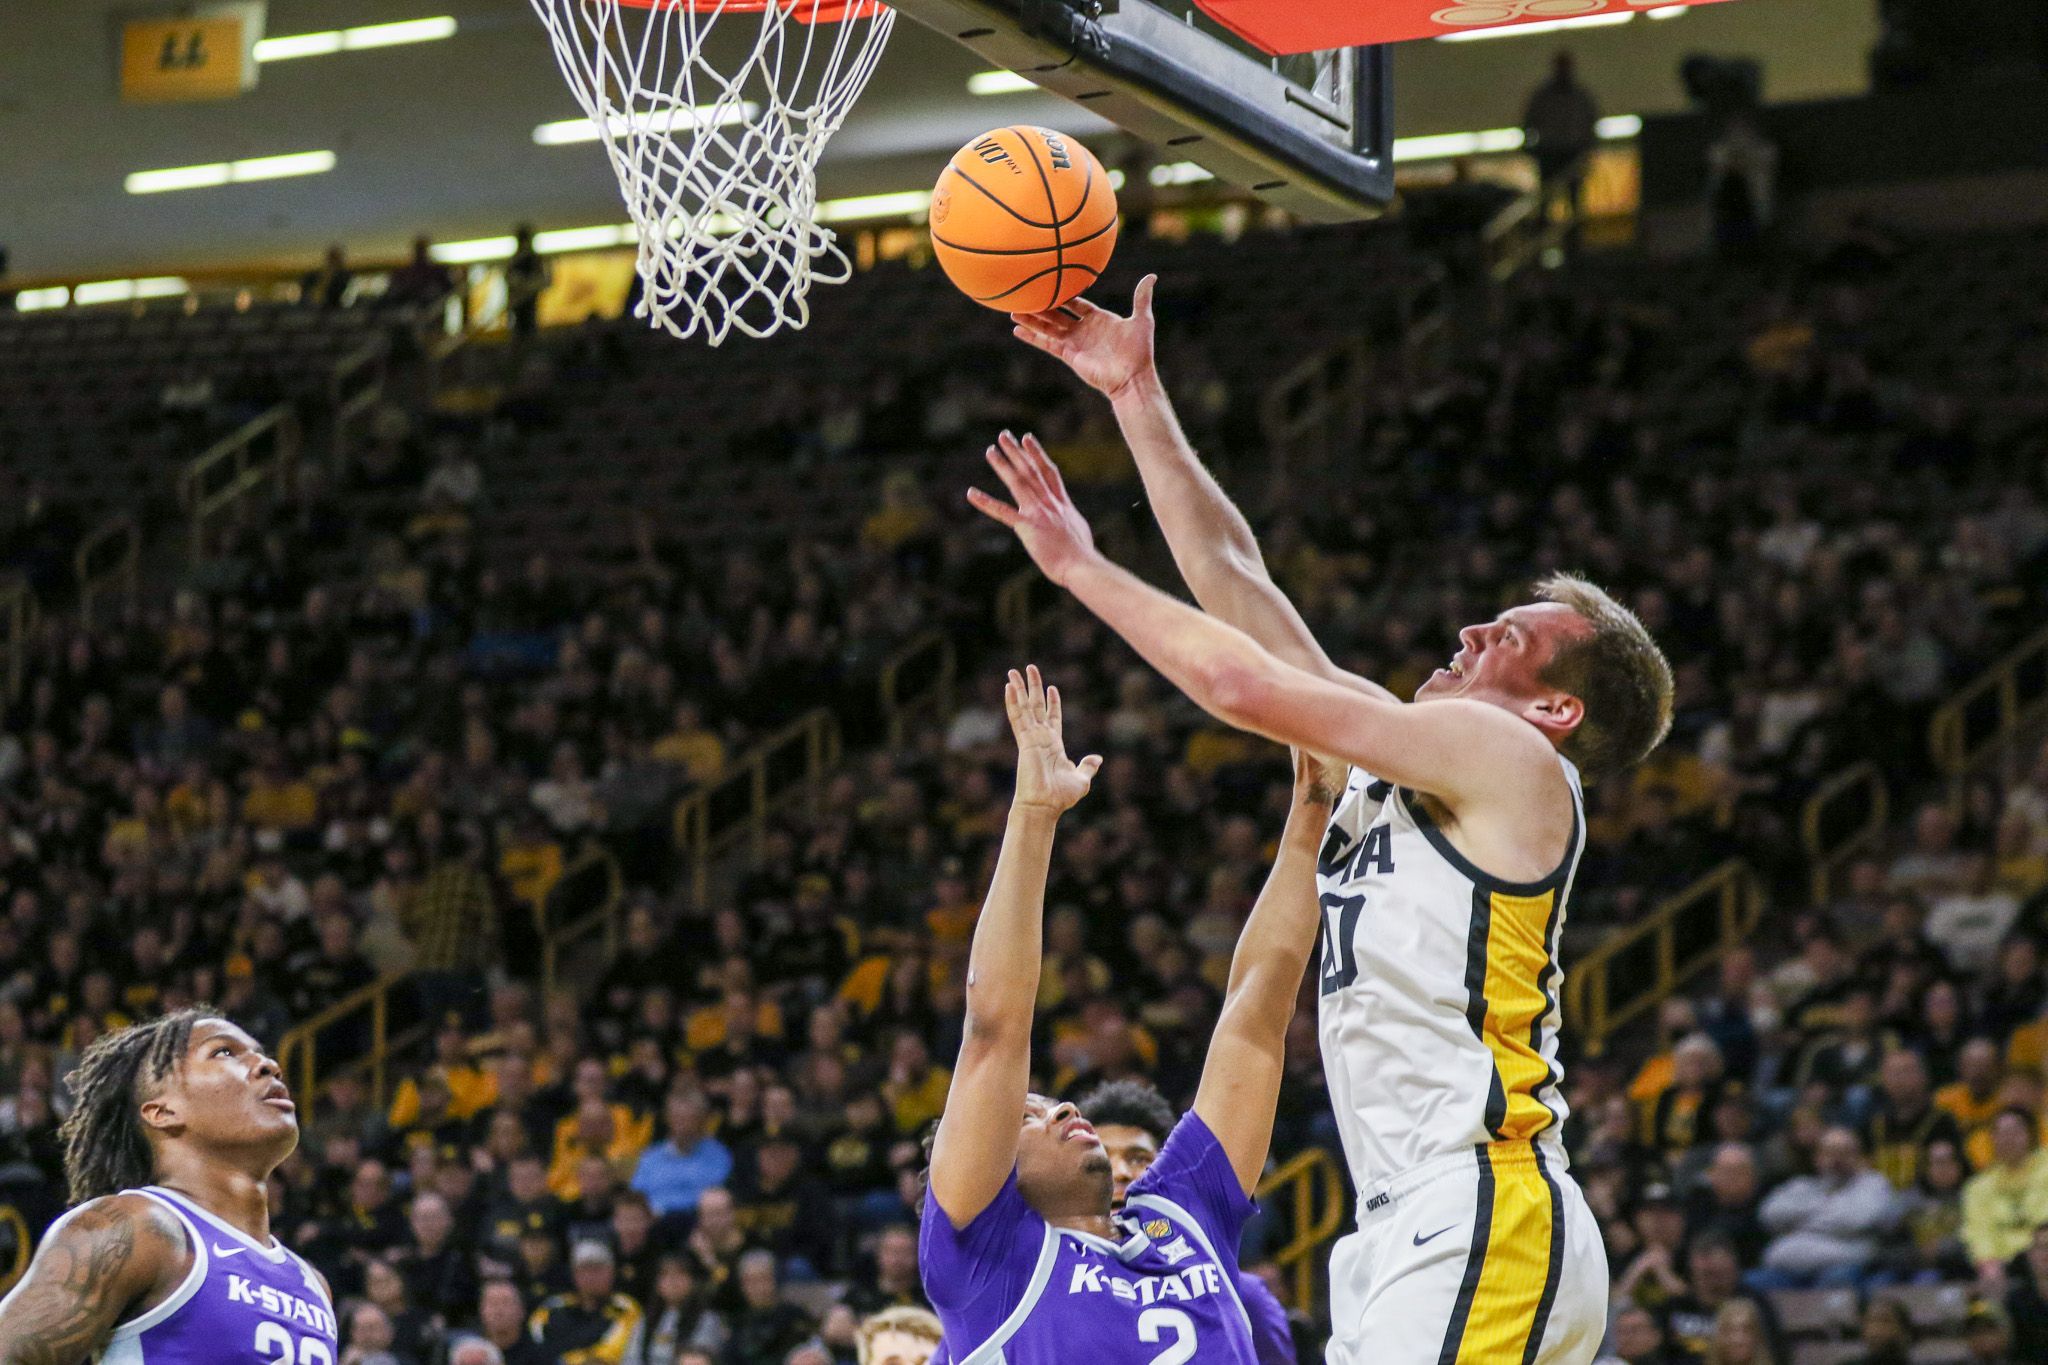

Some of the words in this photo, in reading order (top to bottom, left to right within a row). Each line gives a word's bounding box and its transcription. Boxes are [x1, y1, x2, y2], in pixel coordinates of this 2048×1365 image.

[974, 137, 1009, 164] VO
[1069, 1263, 1220, 1306] K-STATE
[1137, 1307, 1198, 1365] 2
